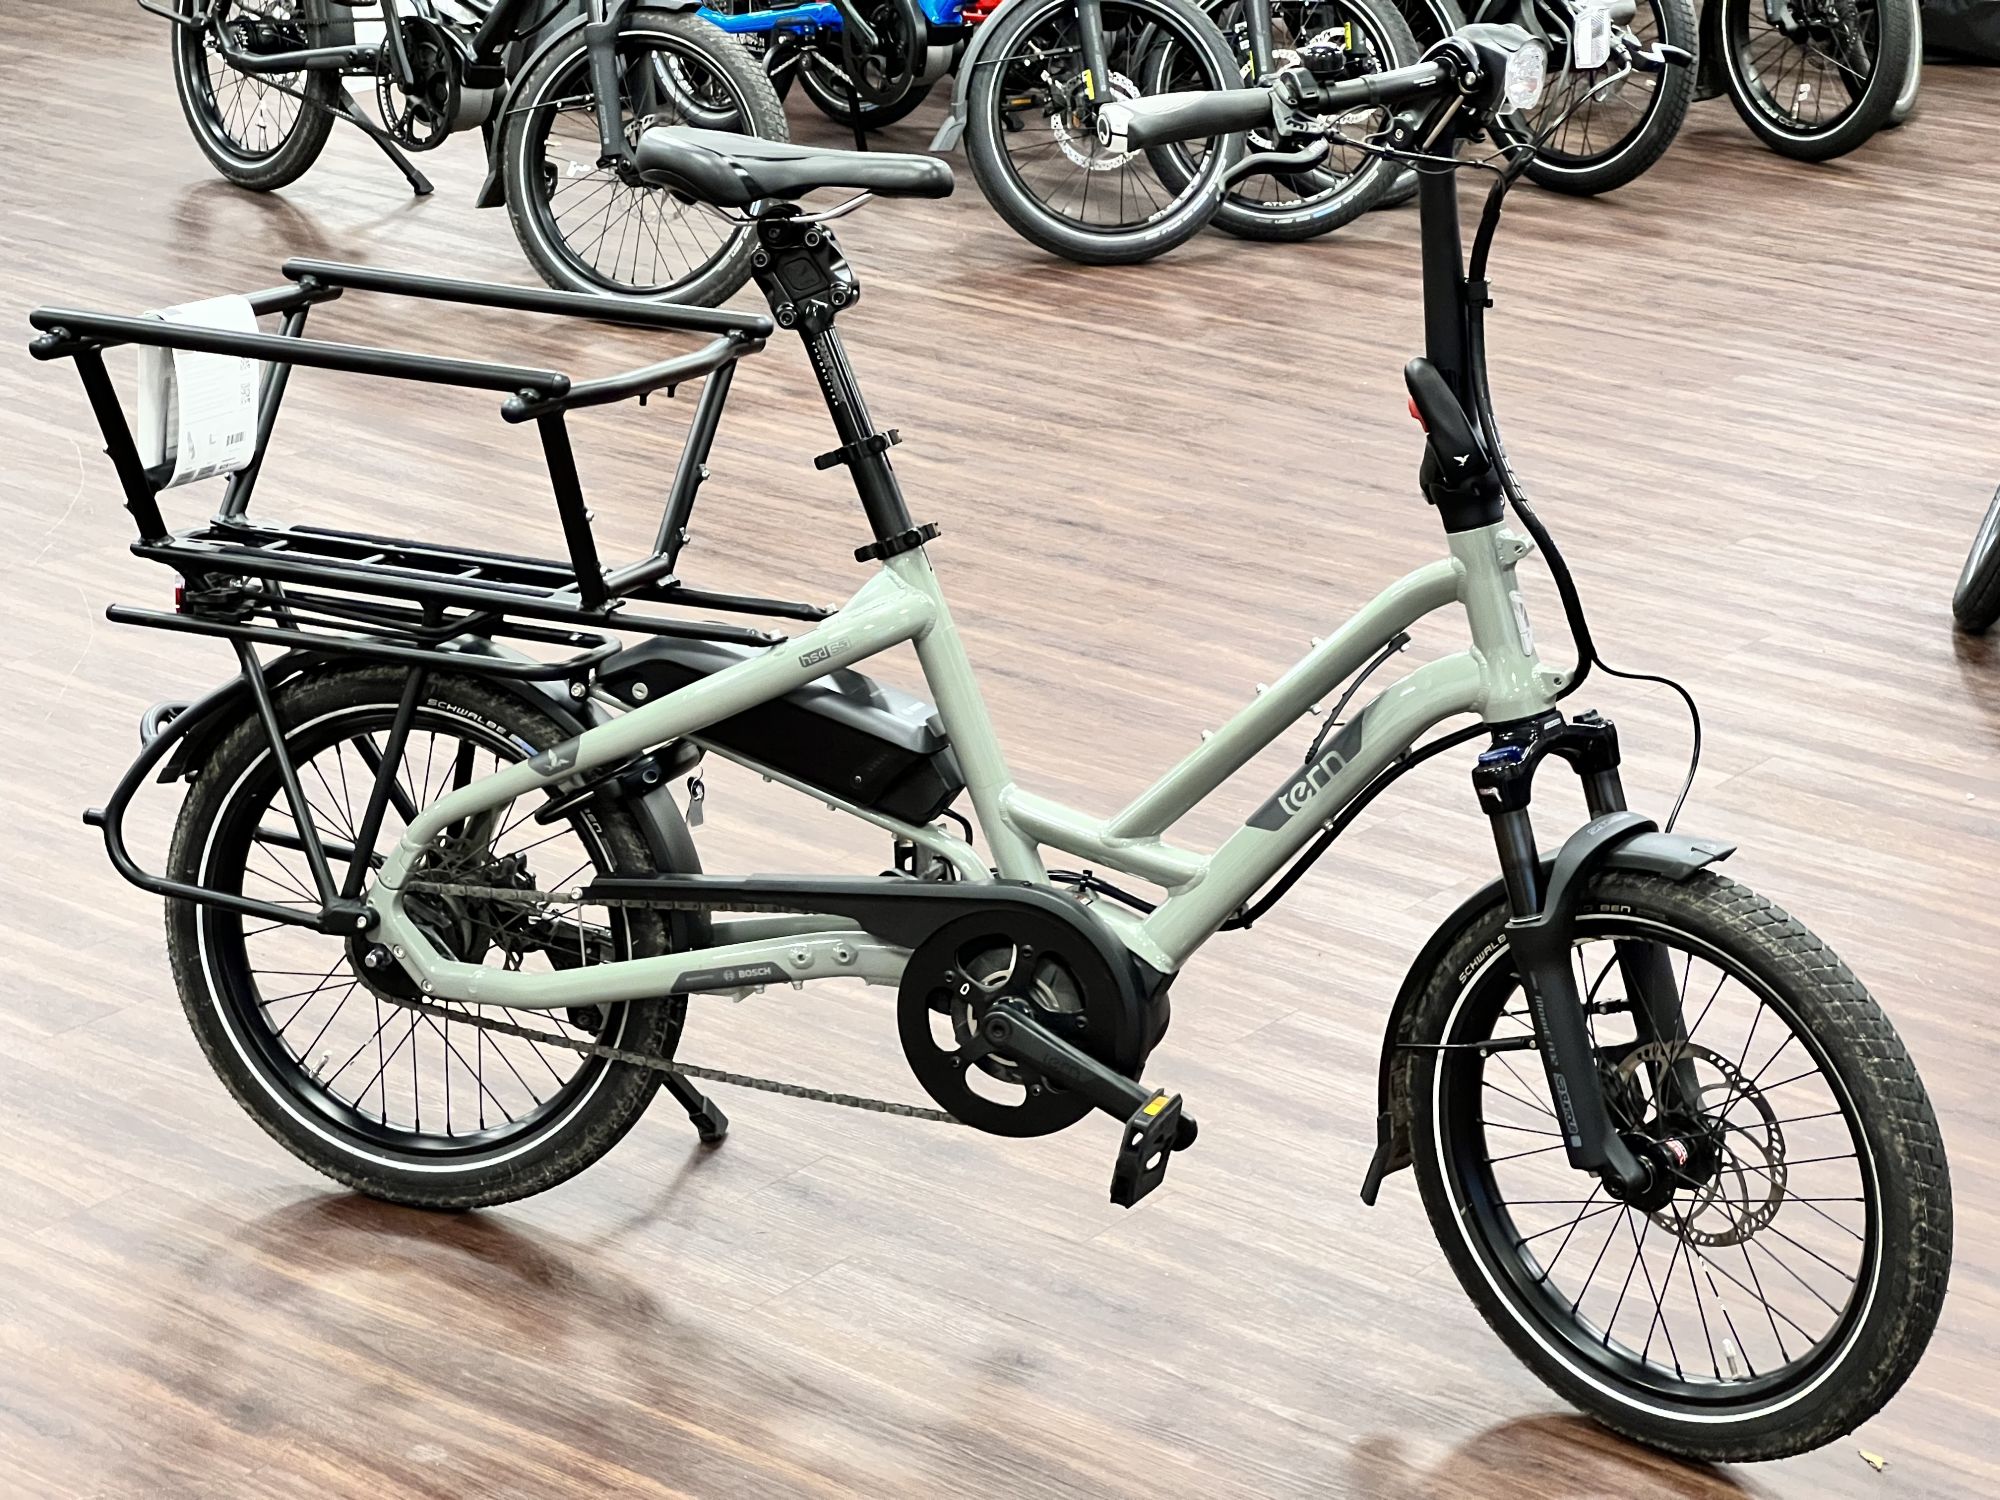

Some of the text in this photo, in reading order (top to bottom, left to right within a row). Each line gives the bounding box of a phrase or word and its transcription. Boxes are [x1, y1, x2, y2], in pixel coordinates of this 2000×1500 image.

[800, 645, 829, 667] hsd
[426, 698, 507, 735] SCHWALBE
[738, 966, 773, 980] BOSCH
[1457, 932, 1508, 985] SCHWALB
